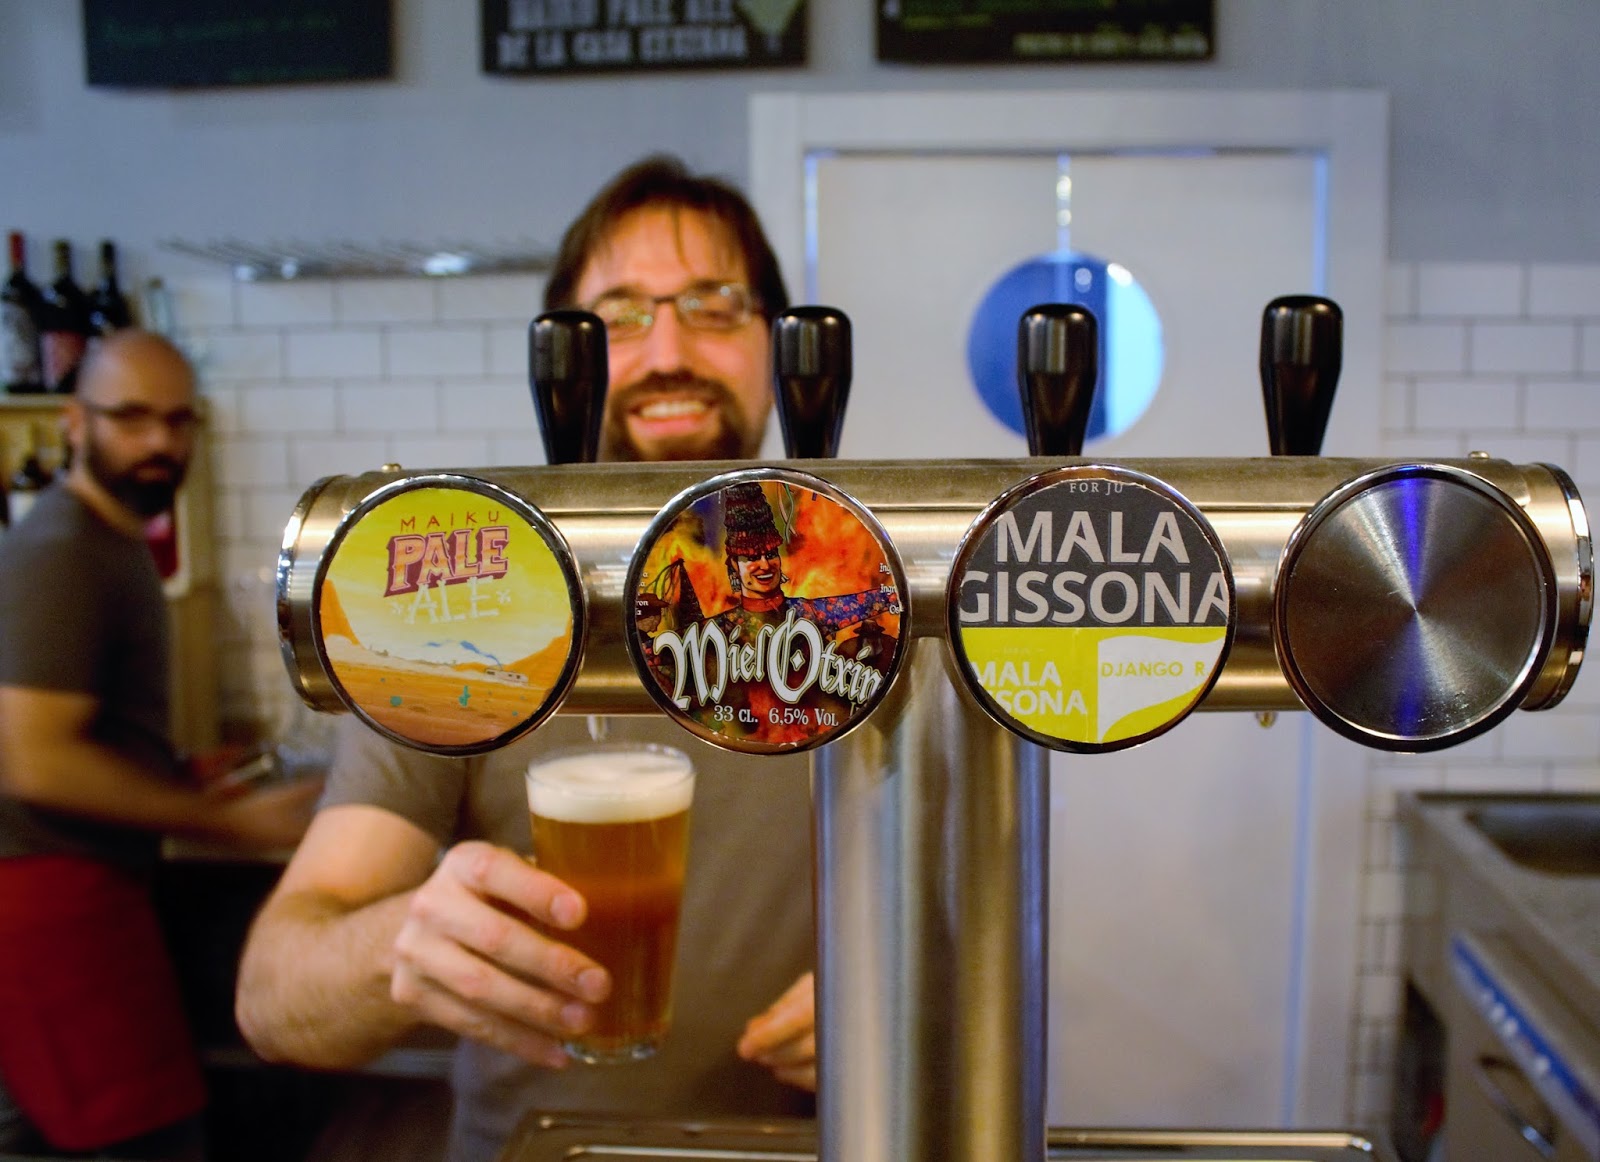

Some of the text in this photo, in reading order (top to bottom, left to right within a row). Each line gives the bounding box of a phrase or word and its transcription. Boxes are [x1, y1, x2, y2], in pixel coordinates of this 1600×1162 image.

[1069, 482, 1100, 493] FOR
[401, 511, 500, 531] MAIKU
[996, 510, 1190, 564] MALA
[384, 526, 509, 597] PALE
[404, 576, 499, 624] ALE
[959, 570, 1230, 624] GISSONA
[971, 661, 1063, 688] MALA
[1101, 660, 1185, 678] DJANGO
[713, 704, 734, 722] 33
[768, 707, 809, 726] 6,5%
